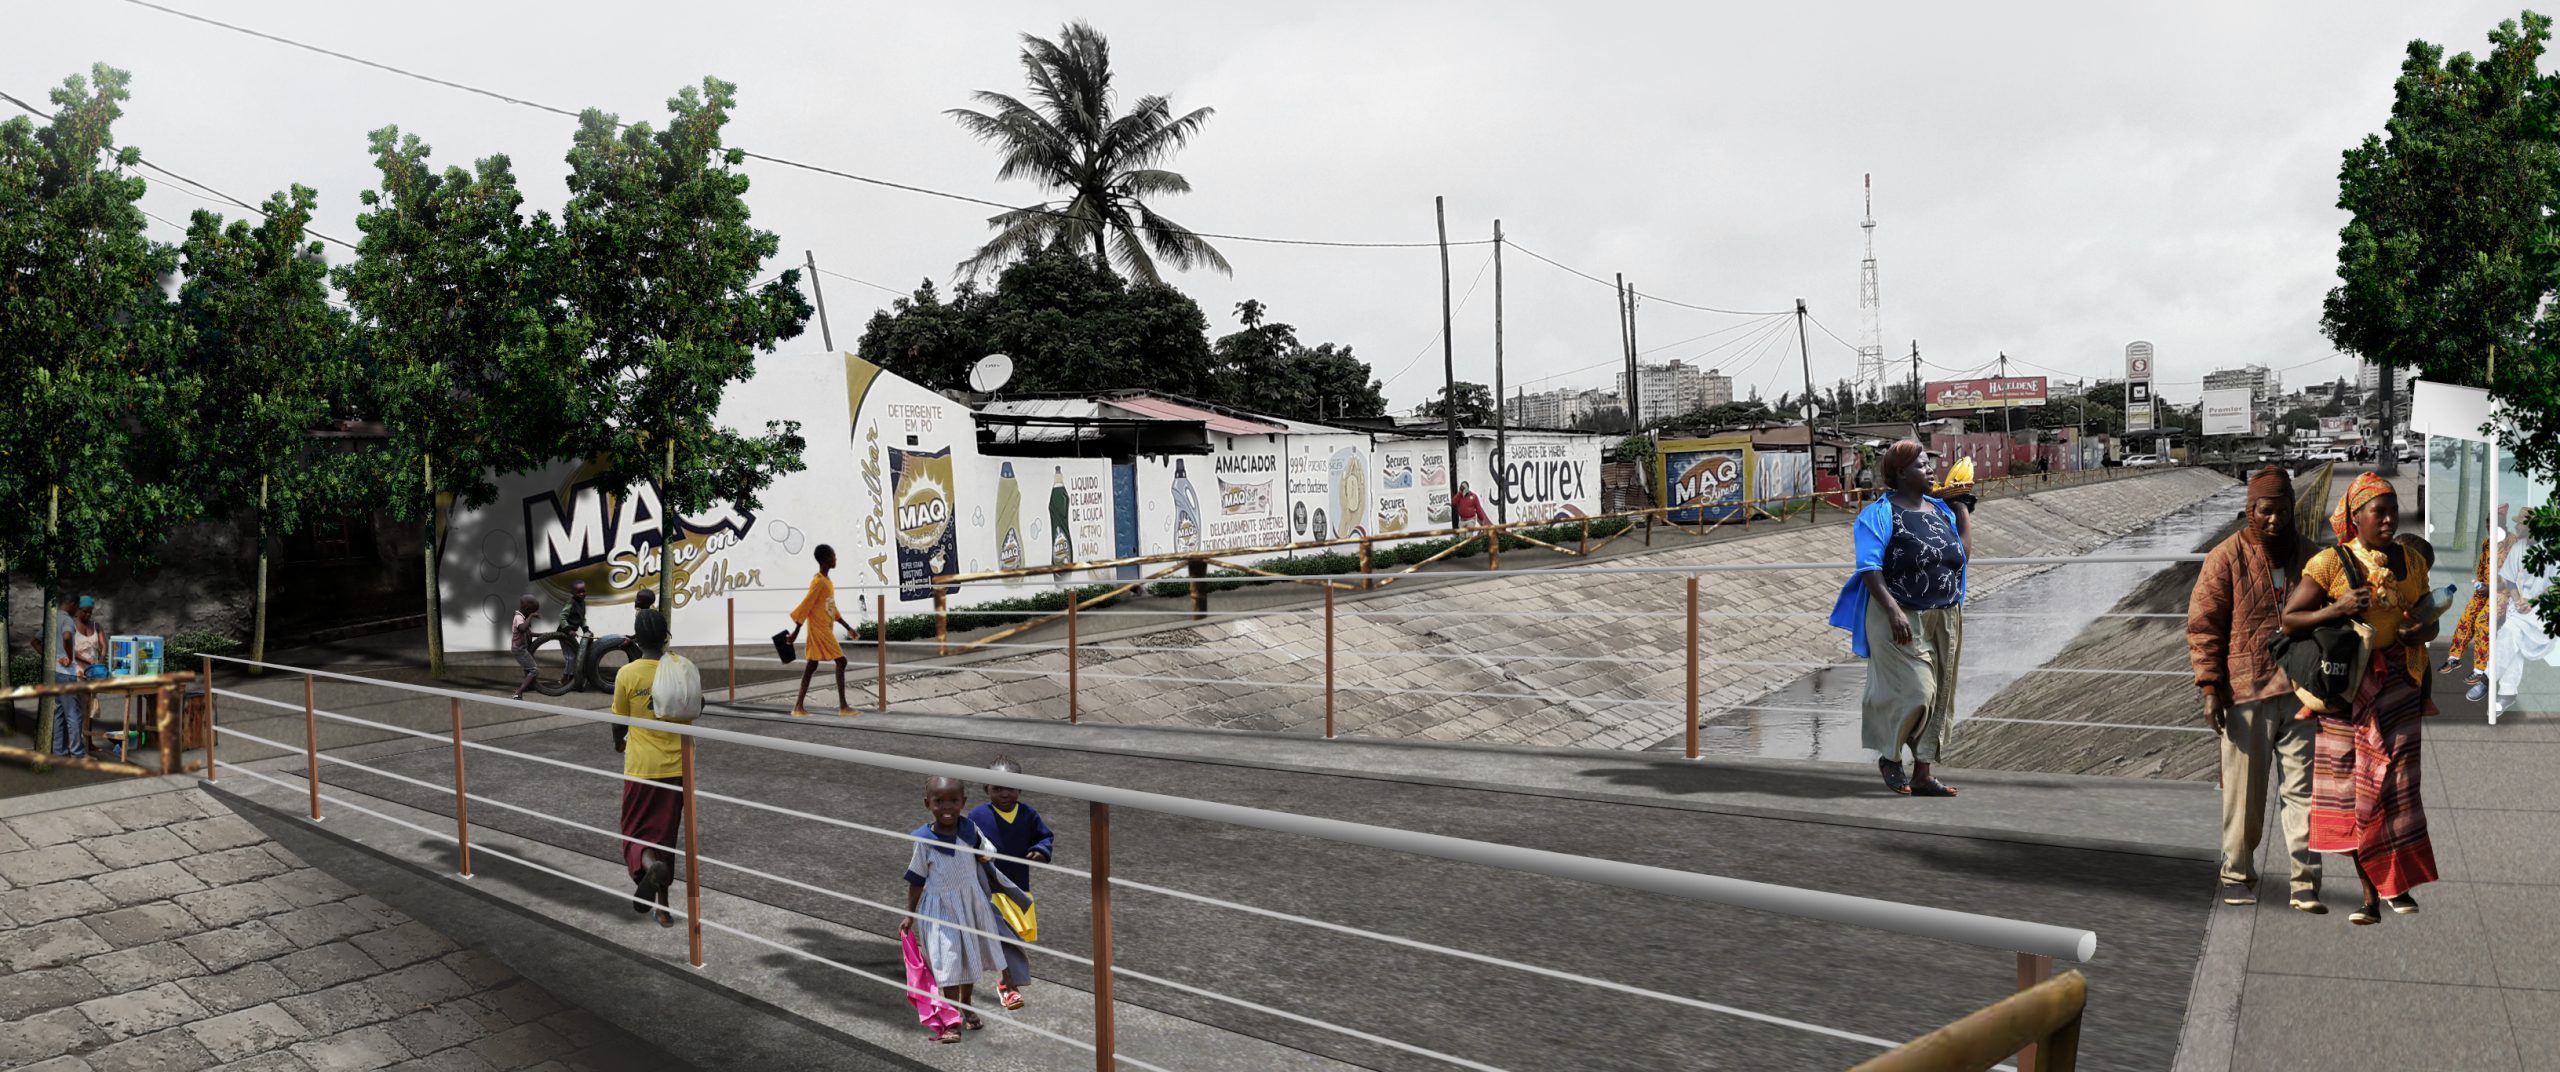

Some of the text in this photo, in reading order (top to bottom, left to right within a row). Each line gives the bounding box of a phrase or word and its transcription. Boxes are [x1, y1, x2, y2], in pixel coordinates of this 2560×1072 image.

[887, 404, 942, 419] DETERGENTE
[905, 419, 918, 432] EM
[1539, 446, 1547, 458] DE
[1215, 455, 1277, 474] AMACIADOR
[1385, 454, 1410, 468] Securex
[1422, 454, 1443, 466] Securex
[1489, 448, 1585, 506] Securex
[1674, 460, 1738, 506] MAQ
[861, 418, 889, 586] A Brilhar
[1071, 492, 1102, 506] DE LAVAGEM
[1224, 491, 1246, 508] MAQ
[1380, 498, 1405, 511] Securex
[1428, 493, 1449, 505] Securex
[898, 496, 946, 531] MAQ
[1072, 508, 1080, 522] DE
[1515, 503, 1557, 521] SABONETE
[1178, 527, 1194, 539] MAQ
[705, 527, 739, 554] on
[1001, 547, 1019, 560] MAQ
[671, 558, 766, 610] Brilhar
